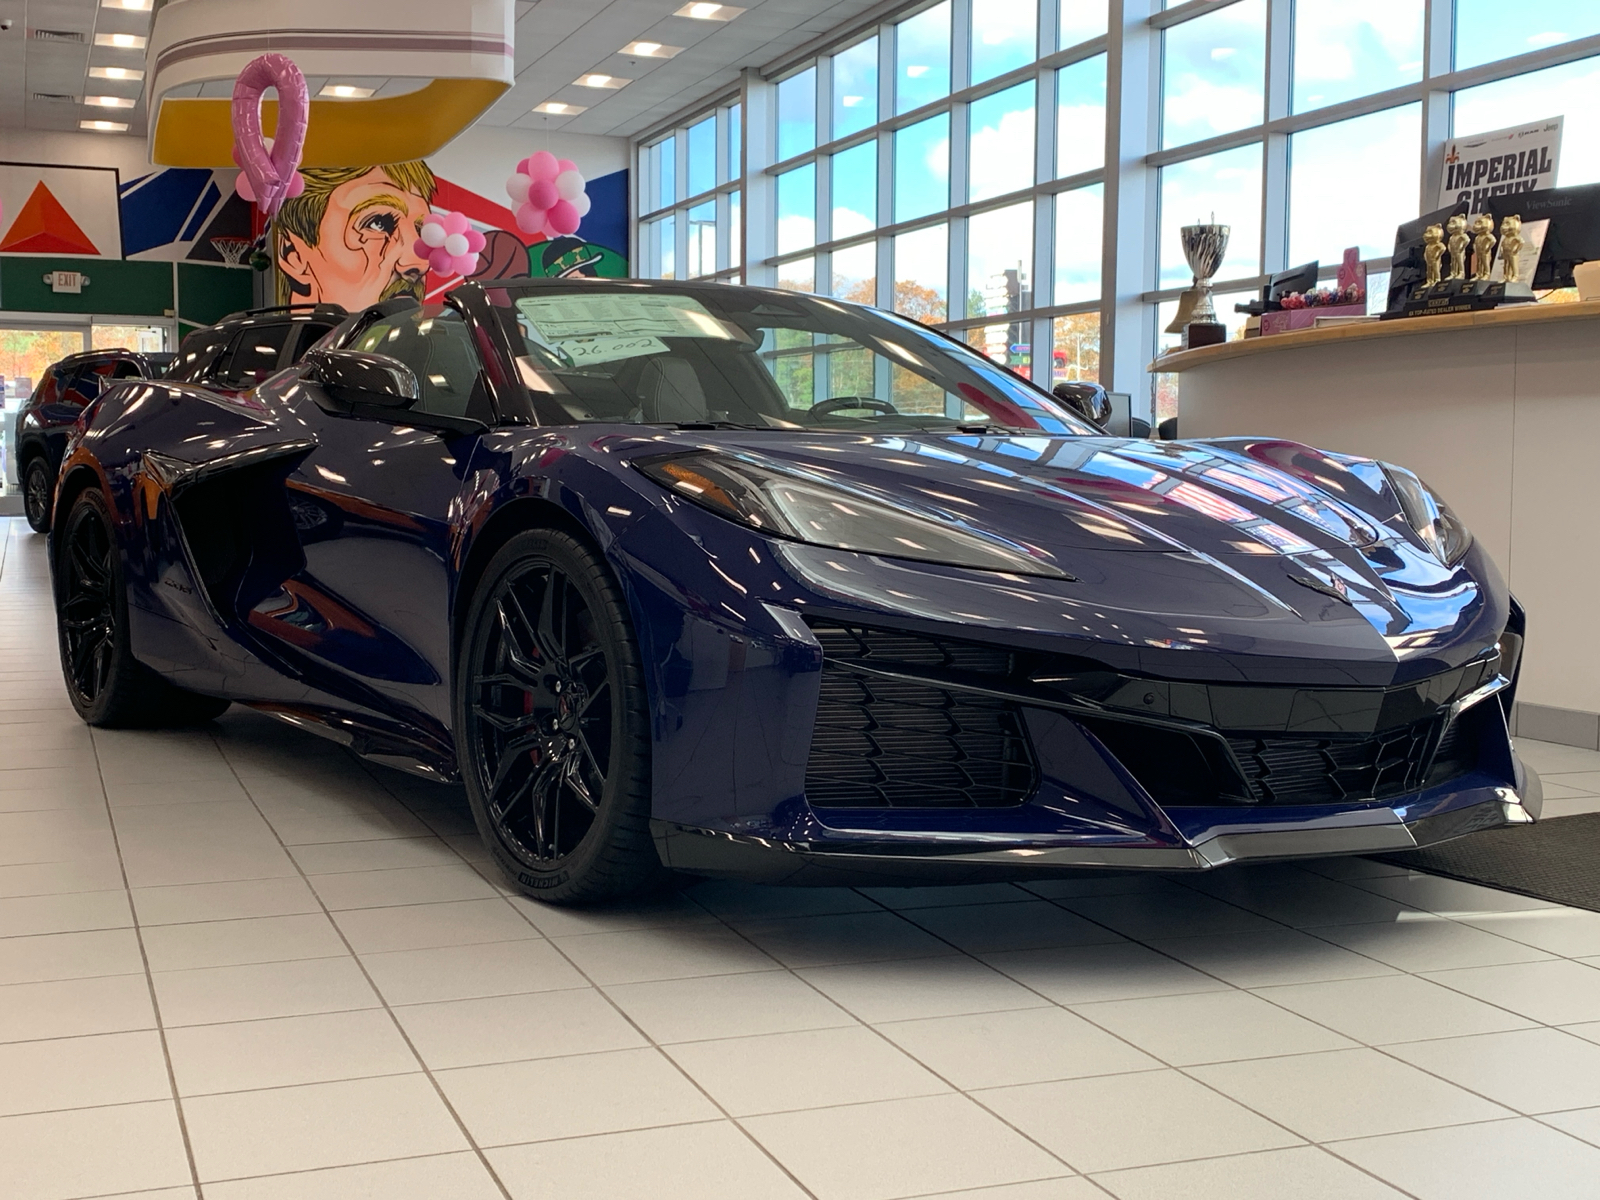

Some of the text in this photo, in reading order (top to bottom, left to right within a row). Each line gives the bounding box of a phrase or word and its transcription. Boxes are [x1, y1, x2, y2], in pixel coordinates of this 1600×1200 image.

[1543, 123, 1559, 132] Jeep
[1446, 146, 1552, 191] IMPERIAL
[1526, 197, 1573, 210] ViewSonic
[59, 274, 77, 286] EXIT
[519, 874, 560, 888] MICHELIN
